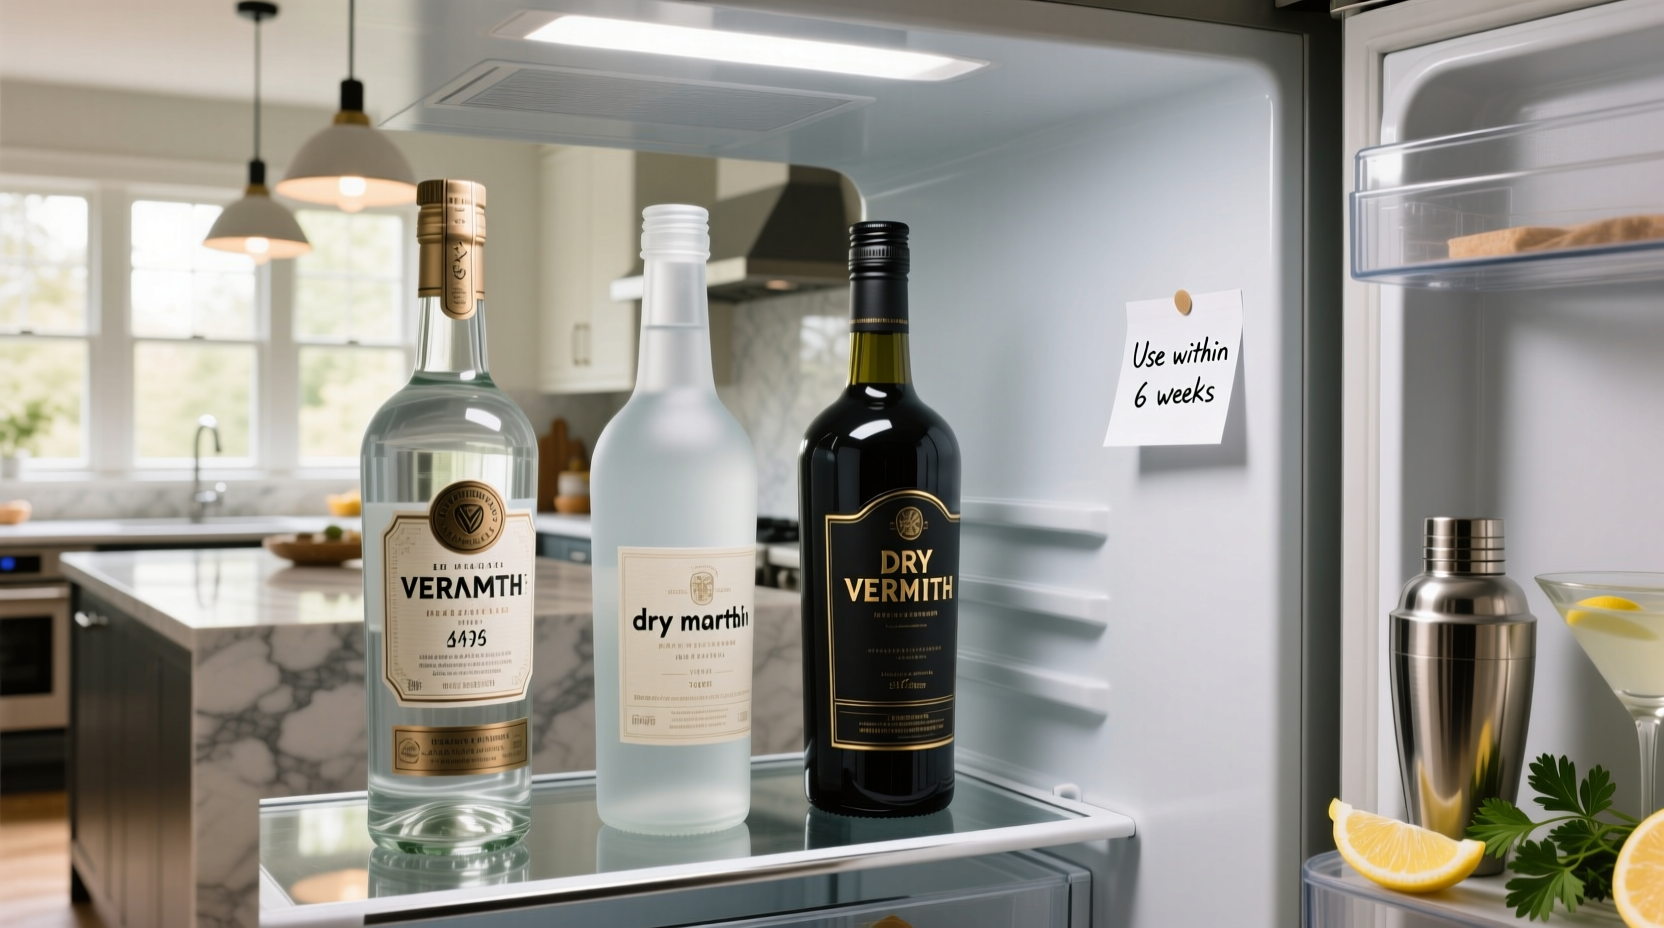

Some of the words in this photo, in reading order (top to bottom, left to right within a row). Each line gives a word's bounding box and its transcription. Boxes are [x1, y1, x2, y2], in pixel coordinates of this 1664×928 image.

[1133, 340, 1165, 368] Use
[1173, 336, 1228, 365] within
[1134, 381, 1148, 408] 6
[1157, 375, 1215, 406] weeks
[881, 549, 933, 574] DRY
[844, 576, 953, 602] VERMITH
[632, 607, 674, 639] dry
